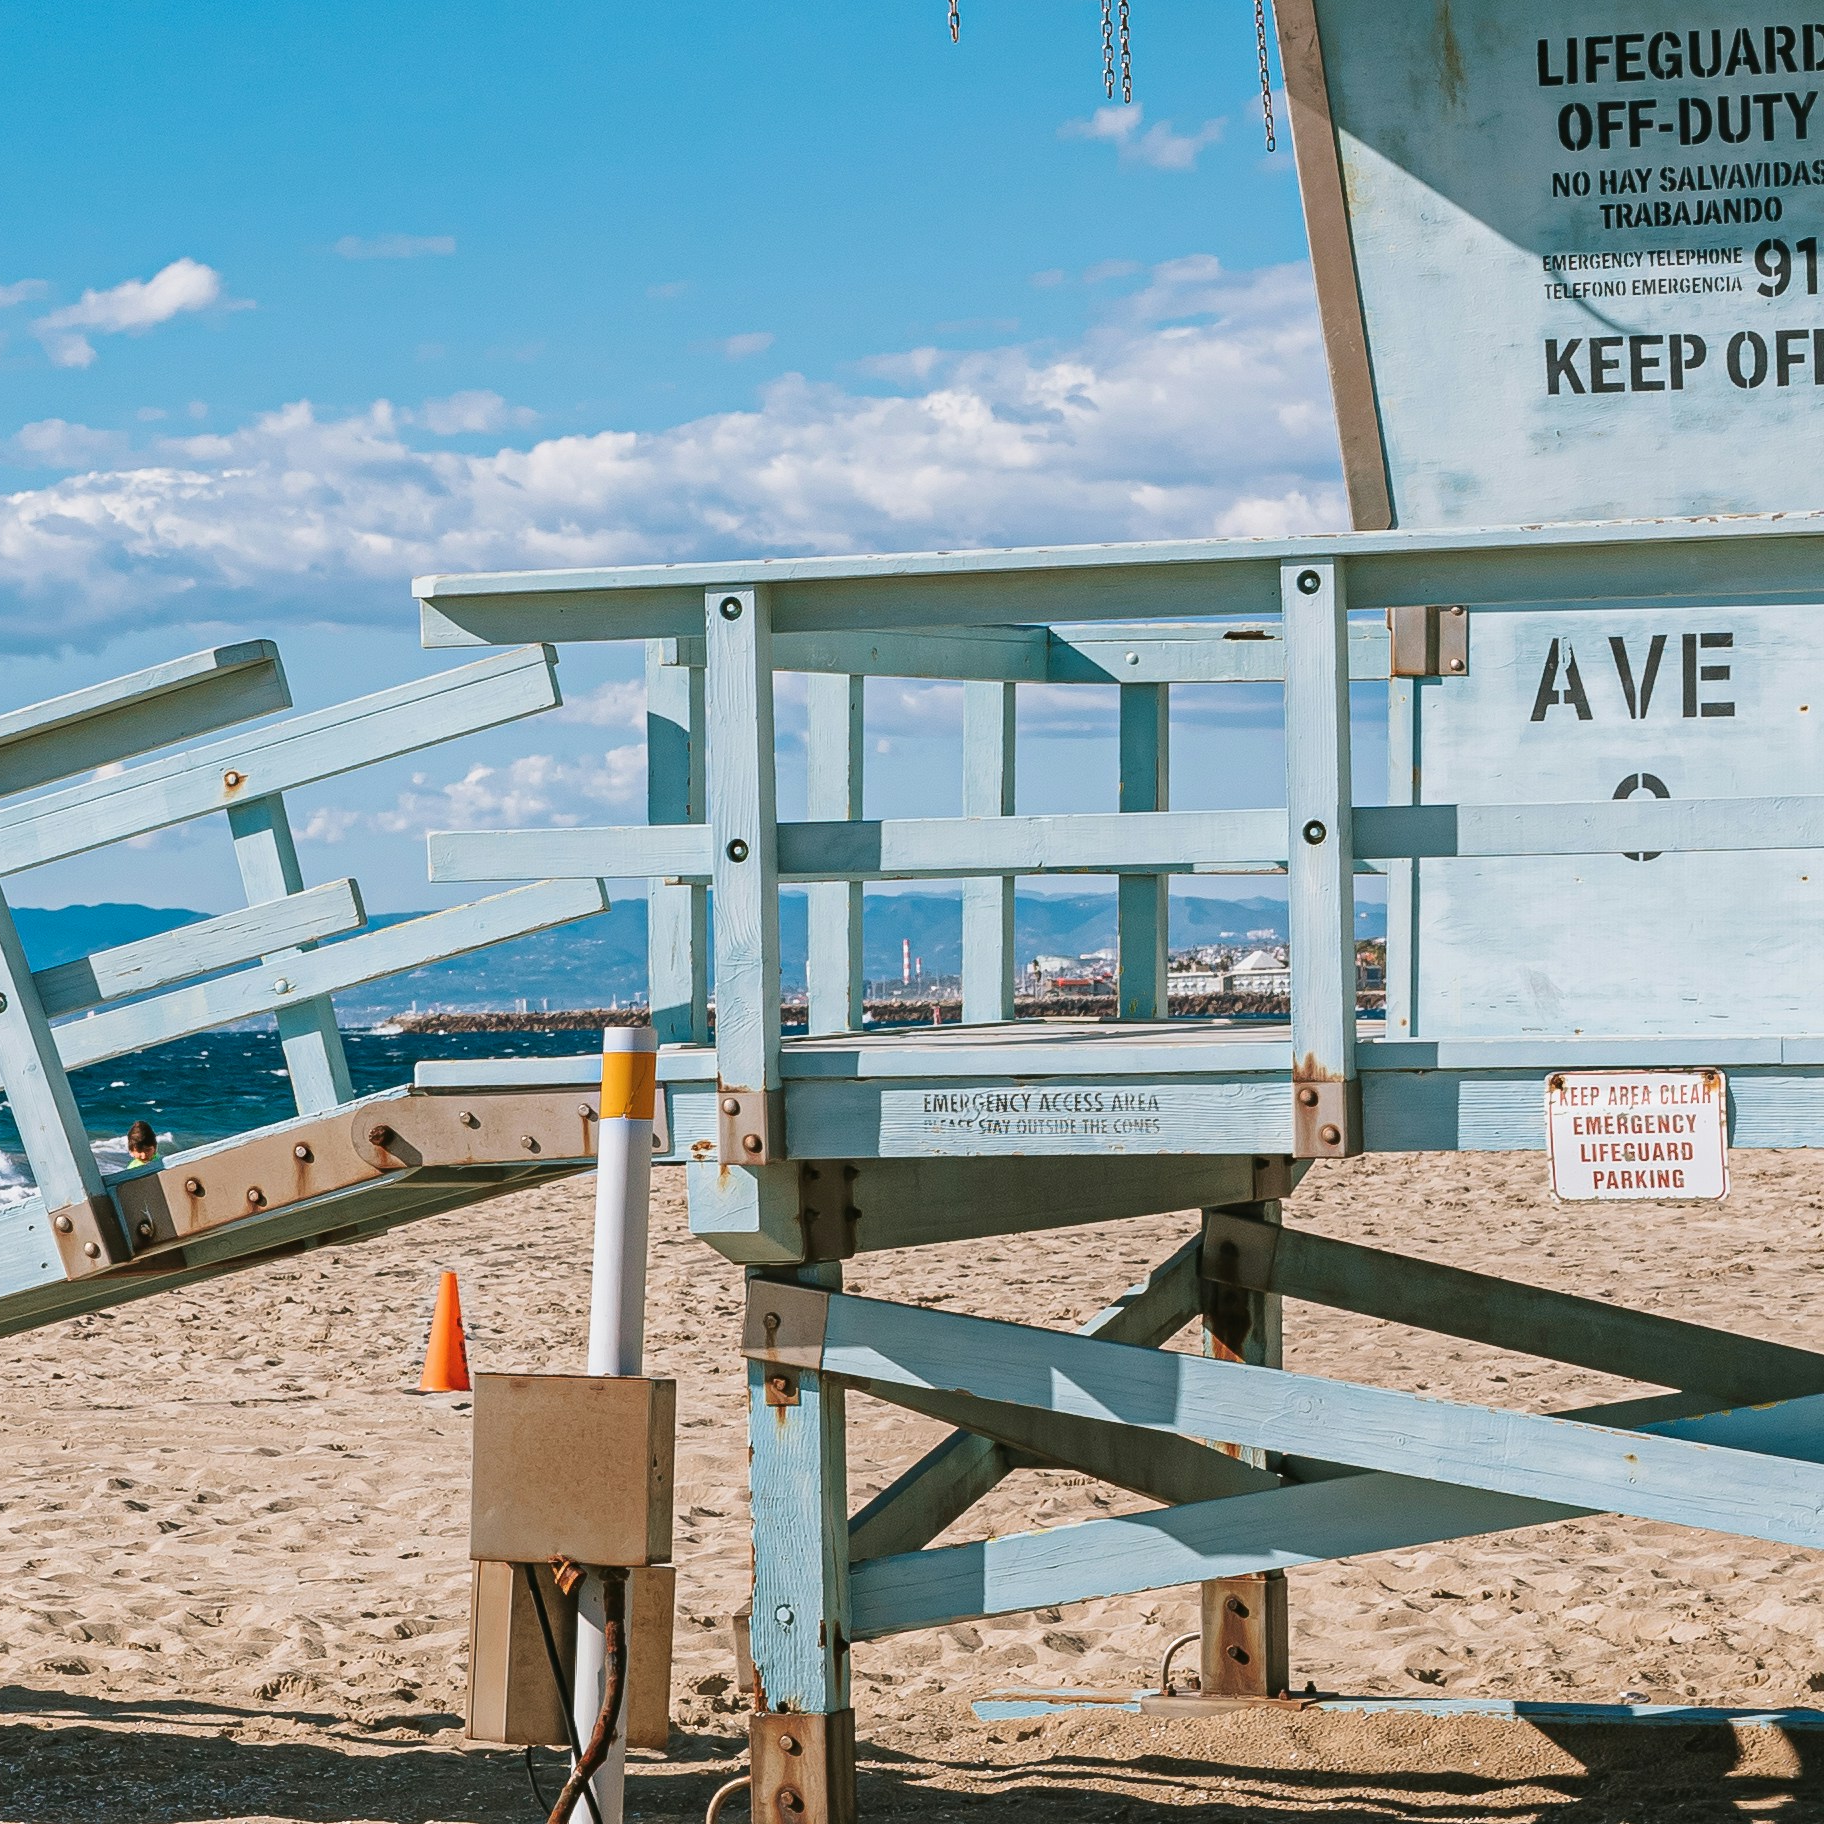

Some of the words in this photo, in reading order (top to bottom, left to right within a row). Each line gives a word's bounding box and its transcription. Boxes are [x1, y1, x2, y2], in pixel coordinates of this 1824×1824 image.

[1537, 24, 1824, 86] LIFEGUARD
[1557, 91, 1818, 151] OFF-DUTY
[1552, 171, 1591, 197] NO
[1599, 168, 1653, 194] HAY
[1659, 160, 1824, 192] SALVAVIDAS
[1600, 196, 1783, 229] TRABAJANDO
[1543, 251, 1644, 271] EMERGENCY
[1647, 247, 1743, 267] TELEPHONE
[1754, 237, 1818, 297] 91
[1544, 281, 1626, 299] TELEFONO
[1632, 276, 1743, 295] EMERGENCIA
[1544, 332, 1707, 395] KEEP
[1530, 633, 1735, 721] AVE
[923, 1093, 1032, 1113] EMERGENCY
[1039, 1092, 1104, 1112] ACCESS
[1111, 1093, 1160, 1112] AREA
[1559, 1087, 1600, 1106] KEEP
[1608, 1084, 1651, 1106] AREA
[1660, 1083, 1712, 1105] CLEAR
[978, 1119, 1010, 1134] STAY
[1016, 1119, 1077, 1134] OUTSIDE
[1082, 1119, 1108, 1134] THE
[1113, 1119, 1160, 1134] CONES
[1572, 1114, 1697, 1135] EMERGENCY
[1580, 1142, 1694, 1162] LIFEGUARD
[1593, 1169, 1685, 1189] PARKING
